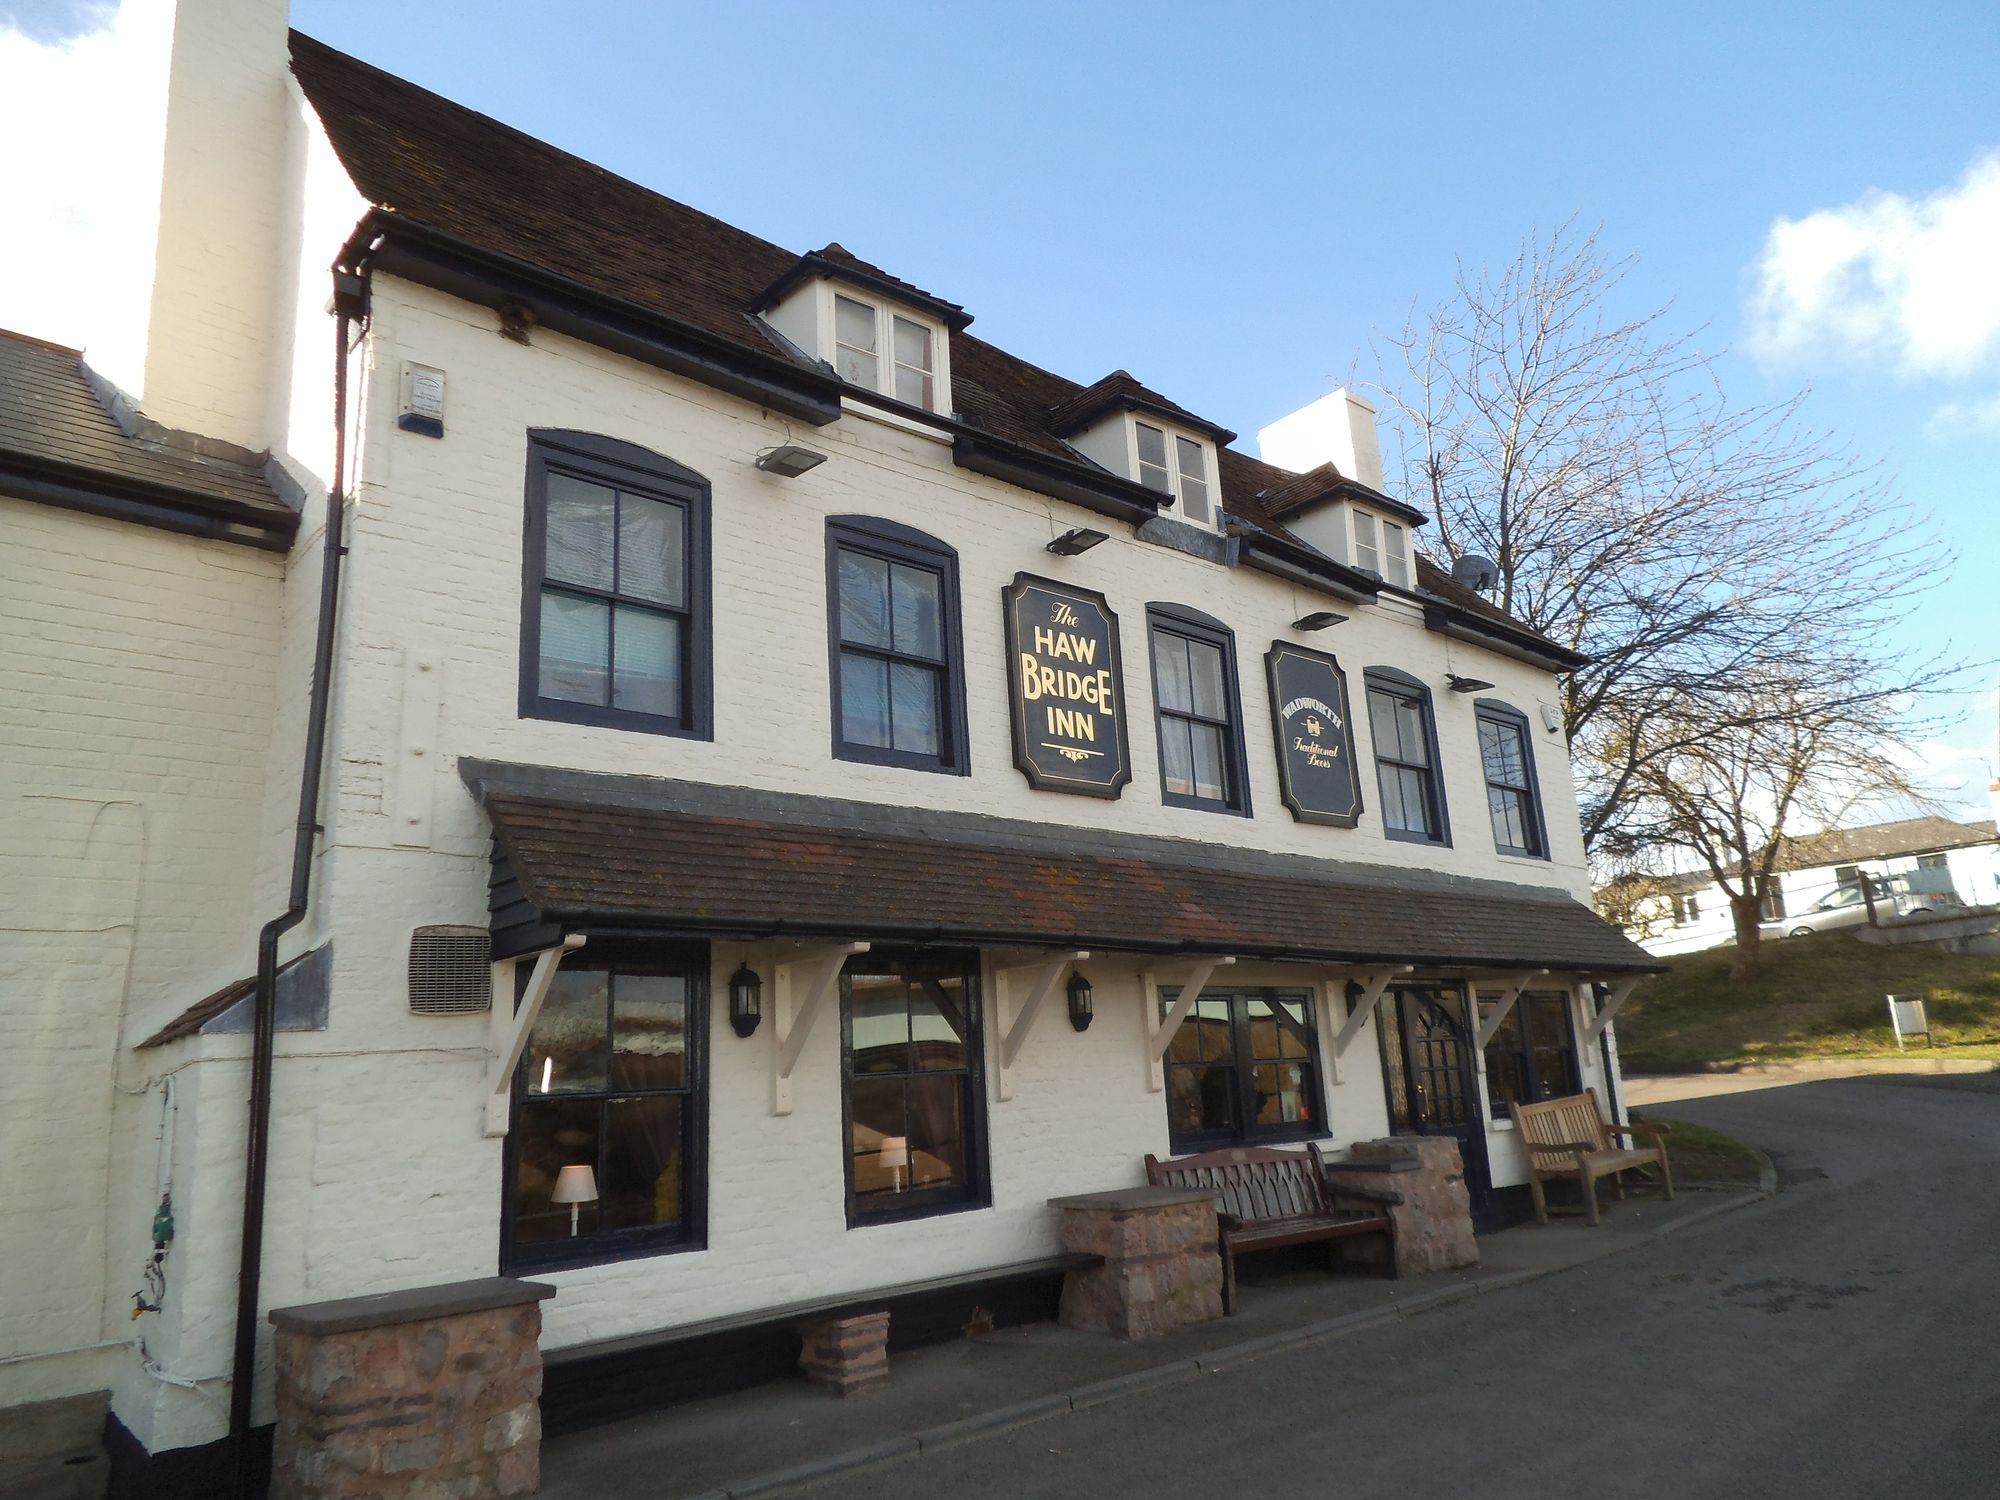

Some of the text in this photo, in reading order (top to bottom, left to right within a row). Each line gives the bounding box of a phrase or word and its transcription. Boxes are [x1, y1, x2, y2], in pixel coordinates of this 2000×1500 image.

[1051, 602, 1079, 627] The
[1034, 626, 1096, 664] HAW
[1021, 653, 1112, 715] BRIDGE
[1046, 707, 1094, 741] INN
[1282, 697, 1342, 729] WADWORTH
[1293, 737, 1338, 757] Traditional
[1307, 754, 1331, 769] Beers
